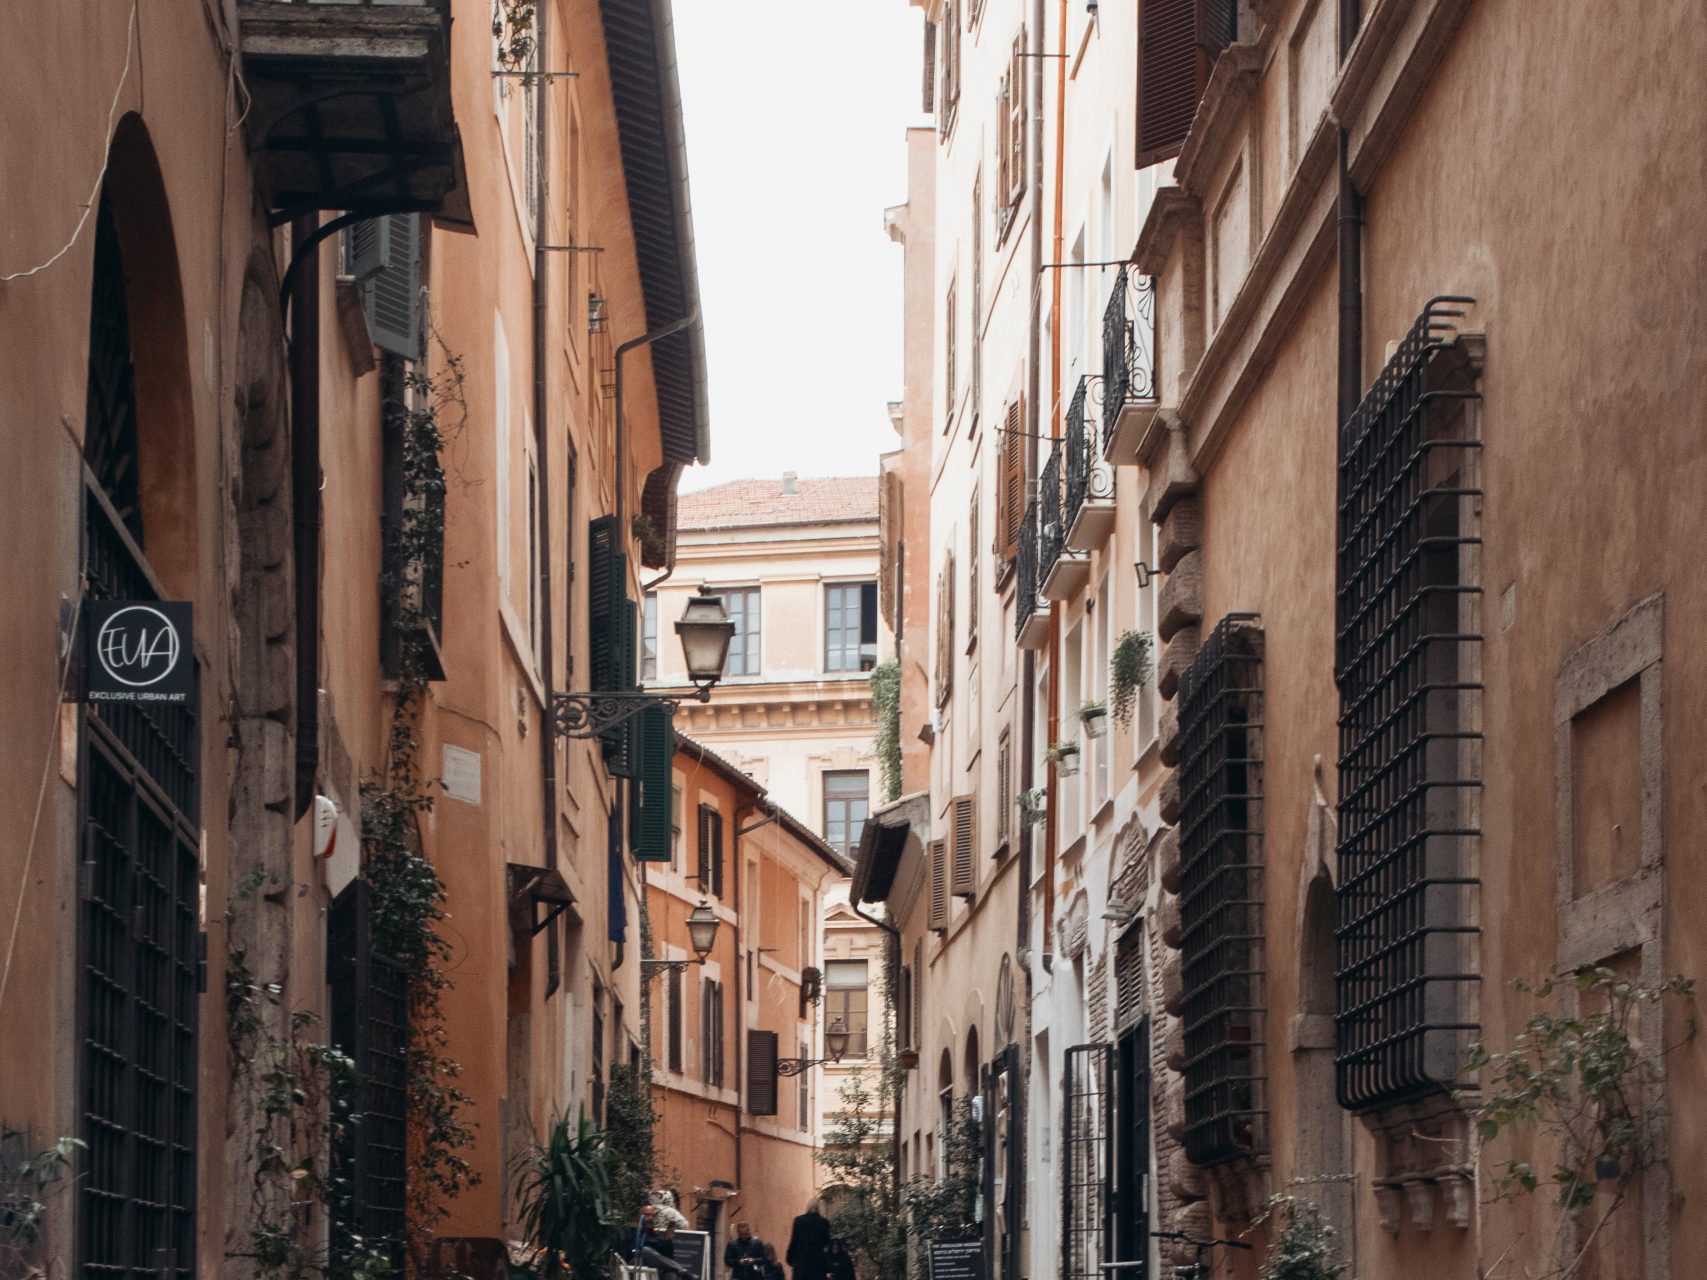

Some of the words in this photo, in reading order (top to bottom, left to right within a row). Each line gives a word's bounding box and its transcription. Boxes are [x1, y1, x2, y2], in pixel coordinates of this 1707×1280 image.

[103, 626, 174, 669] EUA
[89, 691, 135, 700] EXCLUSIVE
[137, 692, 167, 701] URBAN
[169, 693, 186, 701] ART
